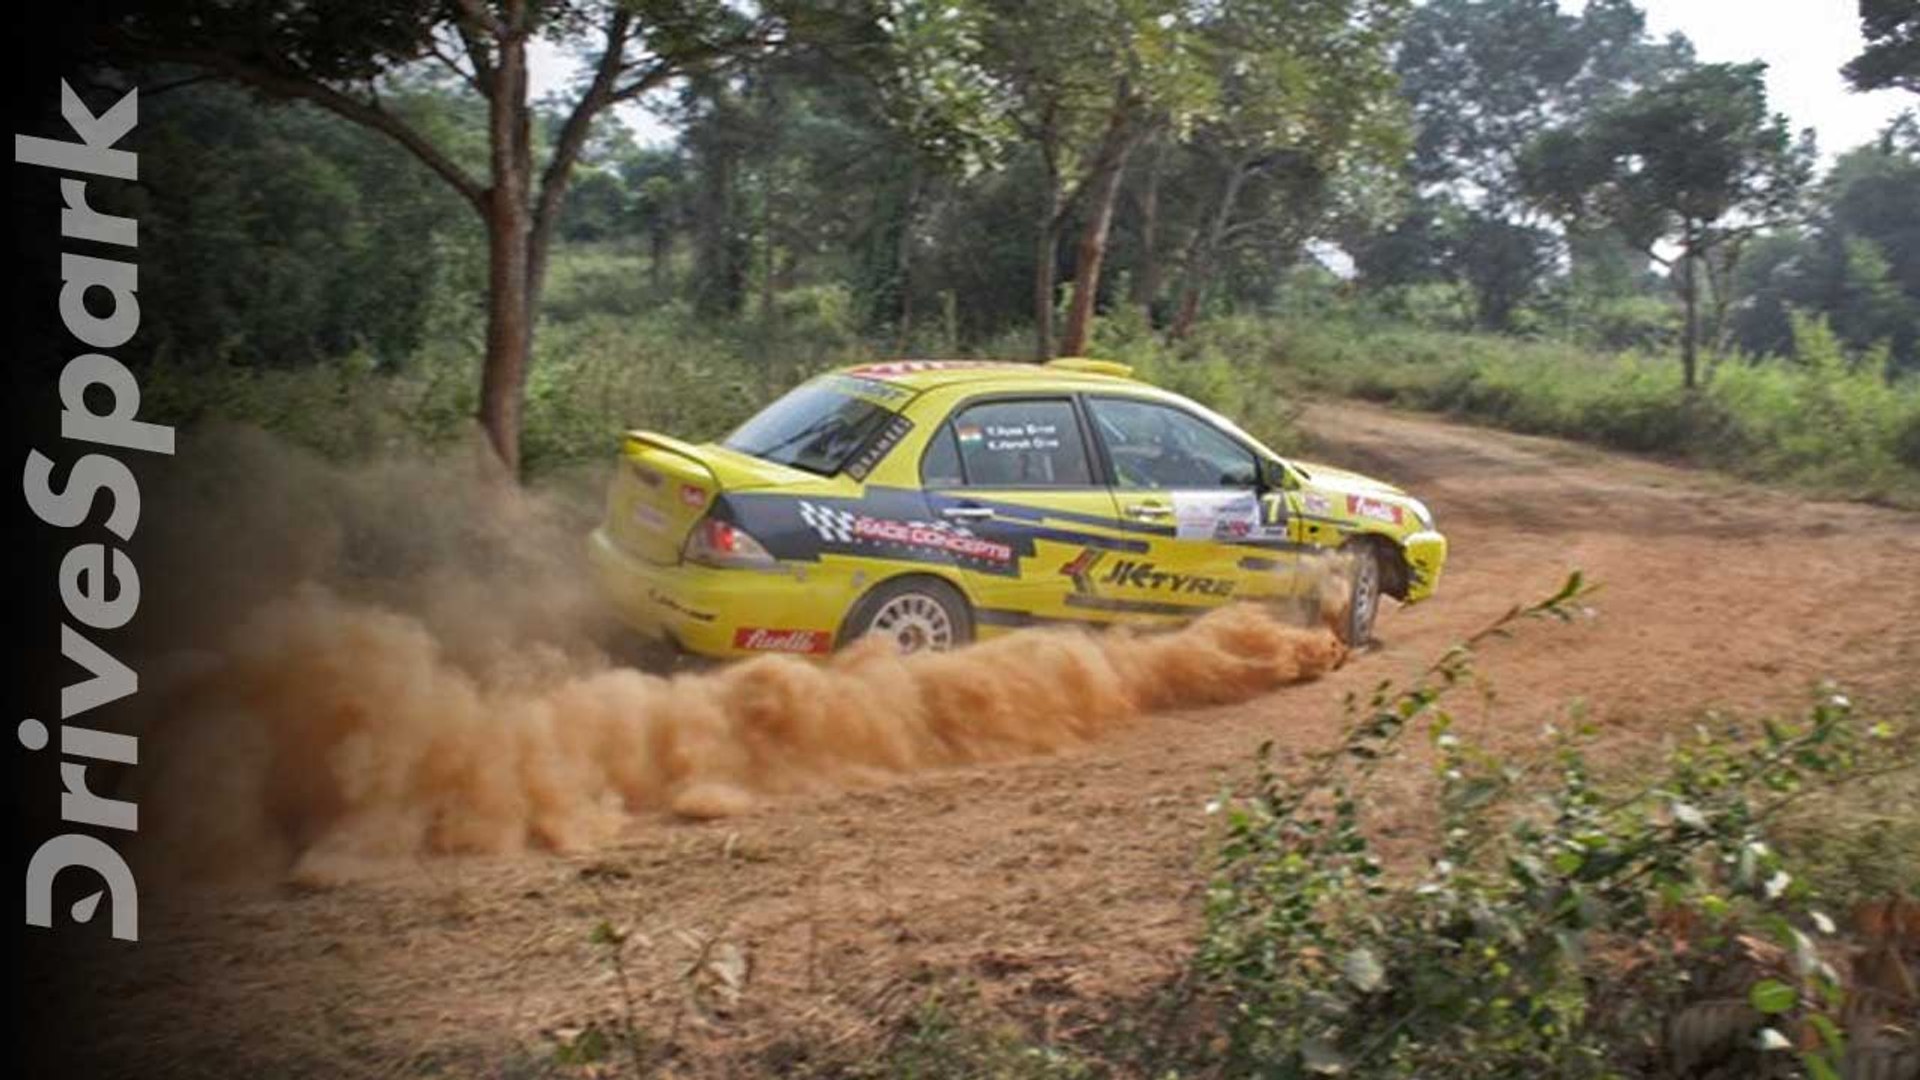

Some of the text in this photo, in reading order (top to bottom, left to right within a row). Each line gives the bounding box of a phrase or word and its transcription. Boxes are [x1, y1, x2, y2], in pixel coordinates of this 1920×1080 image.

[1262, 492, 1281, 523] 7
[854, 515, 1012, 561] RACE CONCEPTS
